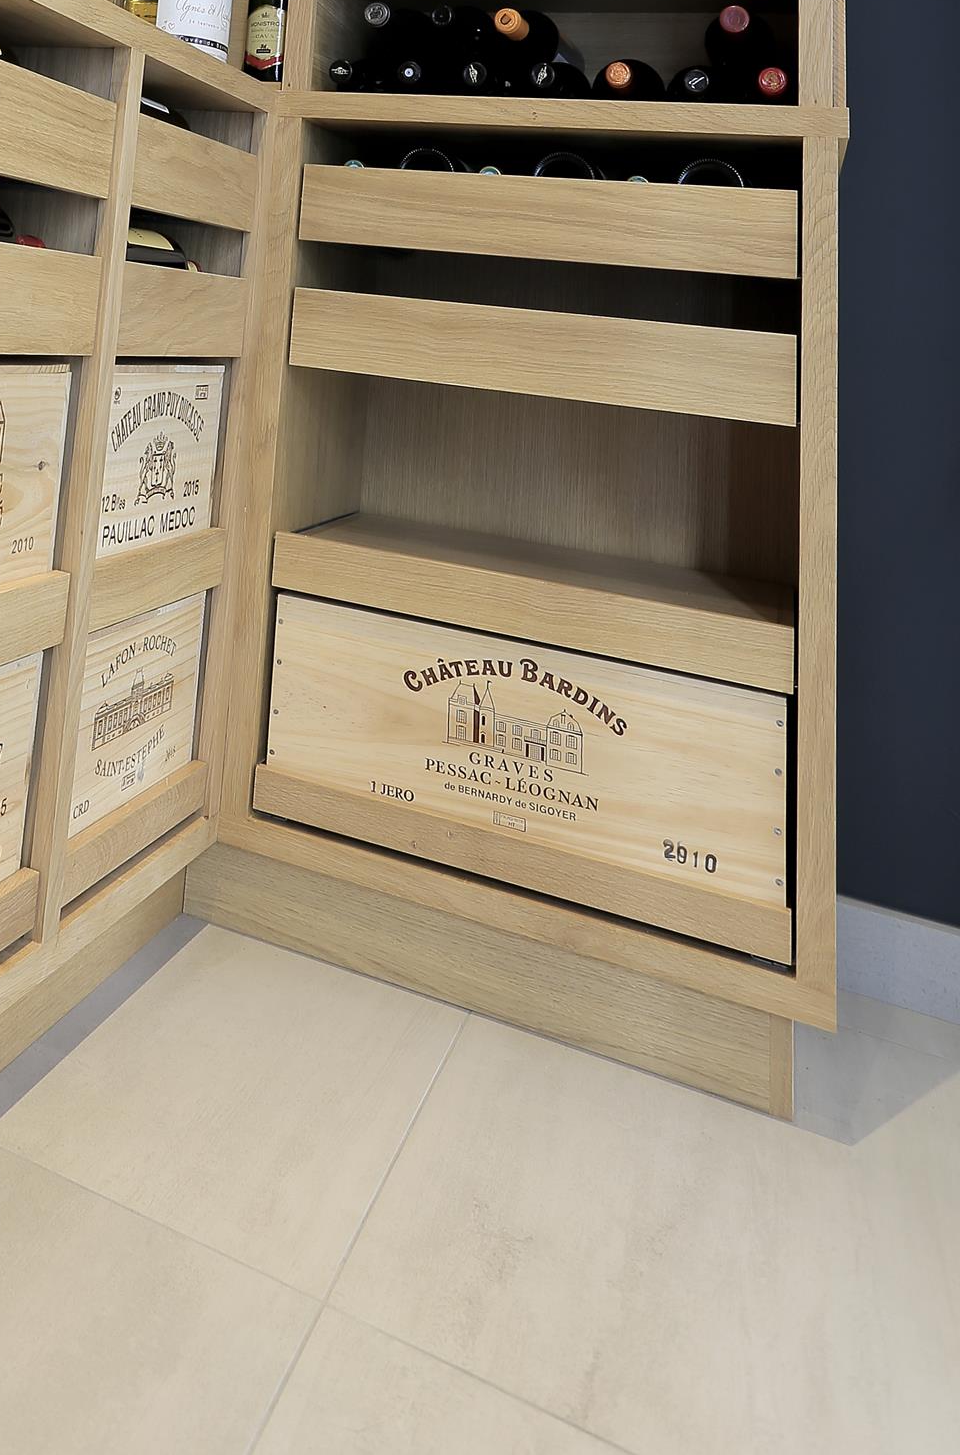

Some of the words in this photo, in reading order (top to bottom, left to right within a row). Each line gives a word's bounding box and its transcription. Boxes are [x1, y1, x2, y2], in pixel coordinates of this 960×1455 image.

[110, 400, 142, 452] CHATEAU
[177, 393, 205, 443] DUCASSE
[101, 494, 110, 513] 12
[183, 479, 200, 498] 2015
[102, 515, 155, 548] PAUILLAC
[159, 506, 196, 532] MEDOC
[11, 536, 34, 555] 2010
[403, 657, 513, 693] CHÂTEAU
[520, 658, 629, 736] BARDINS
[469, 751, 553, 782] GRAVES
[379, 782, 415, 804] JERO
[444, 781, 456, 791] de
[458, 785, 513, 806] BERNARDY
[515, 798, 527, 809] de
[528, 801, 577, 821] SIGOYER
[73, 800, 90, 819] CRD
[663, 839, 717, 873] 2010
